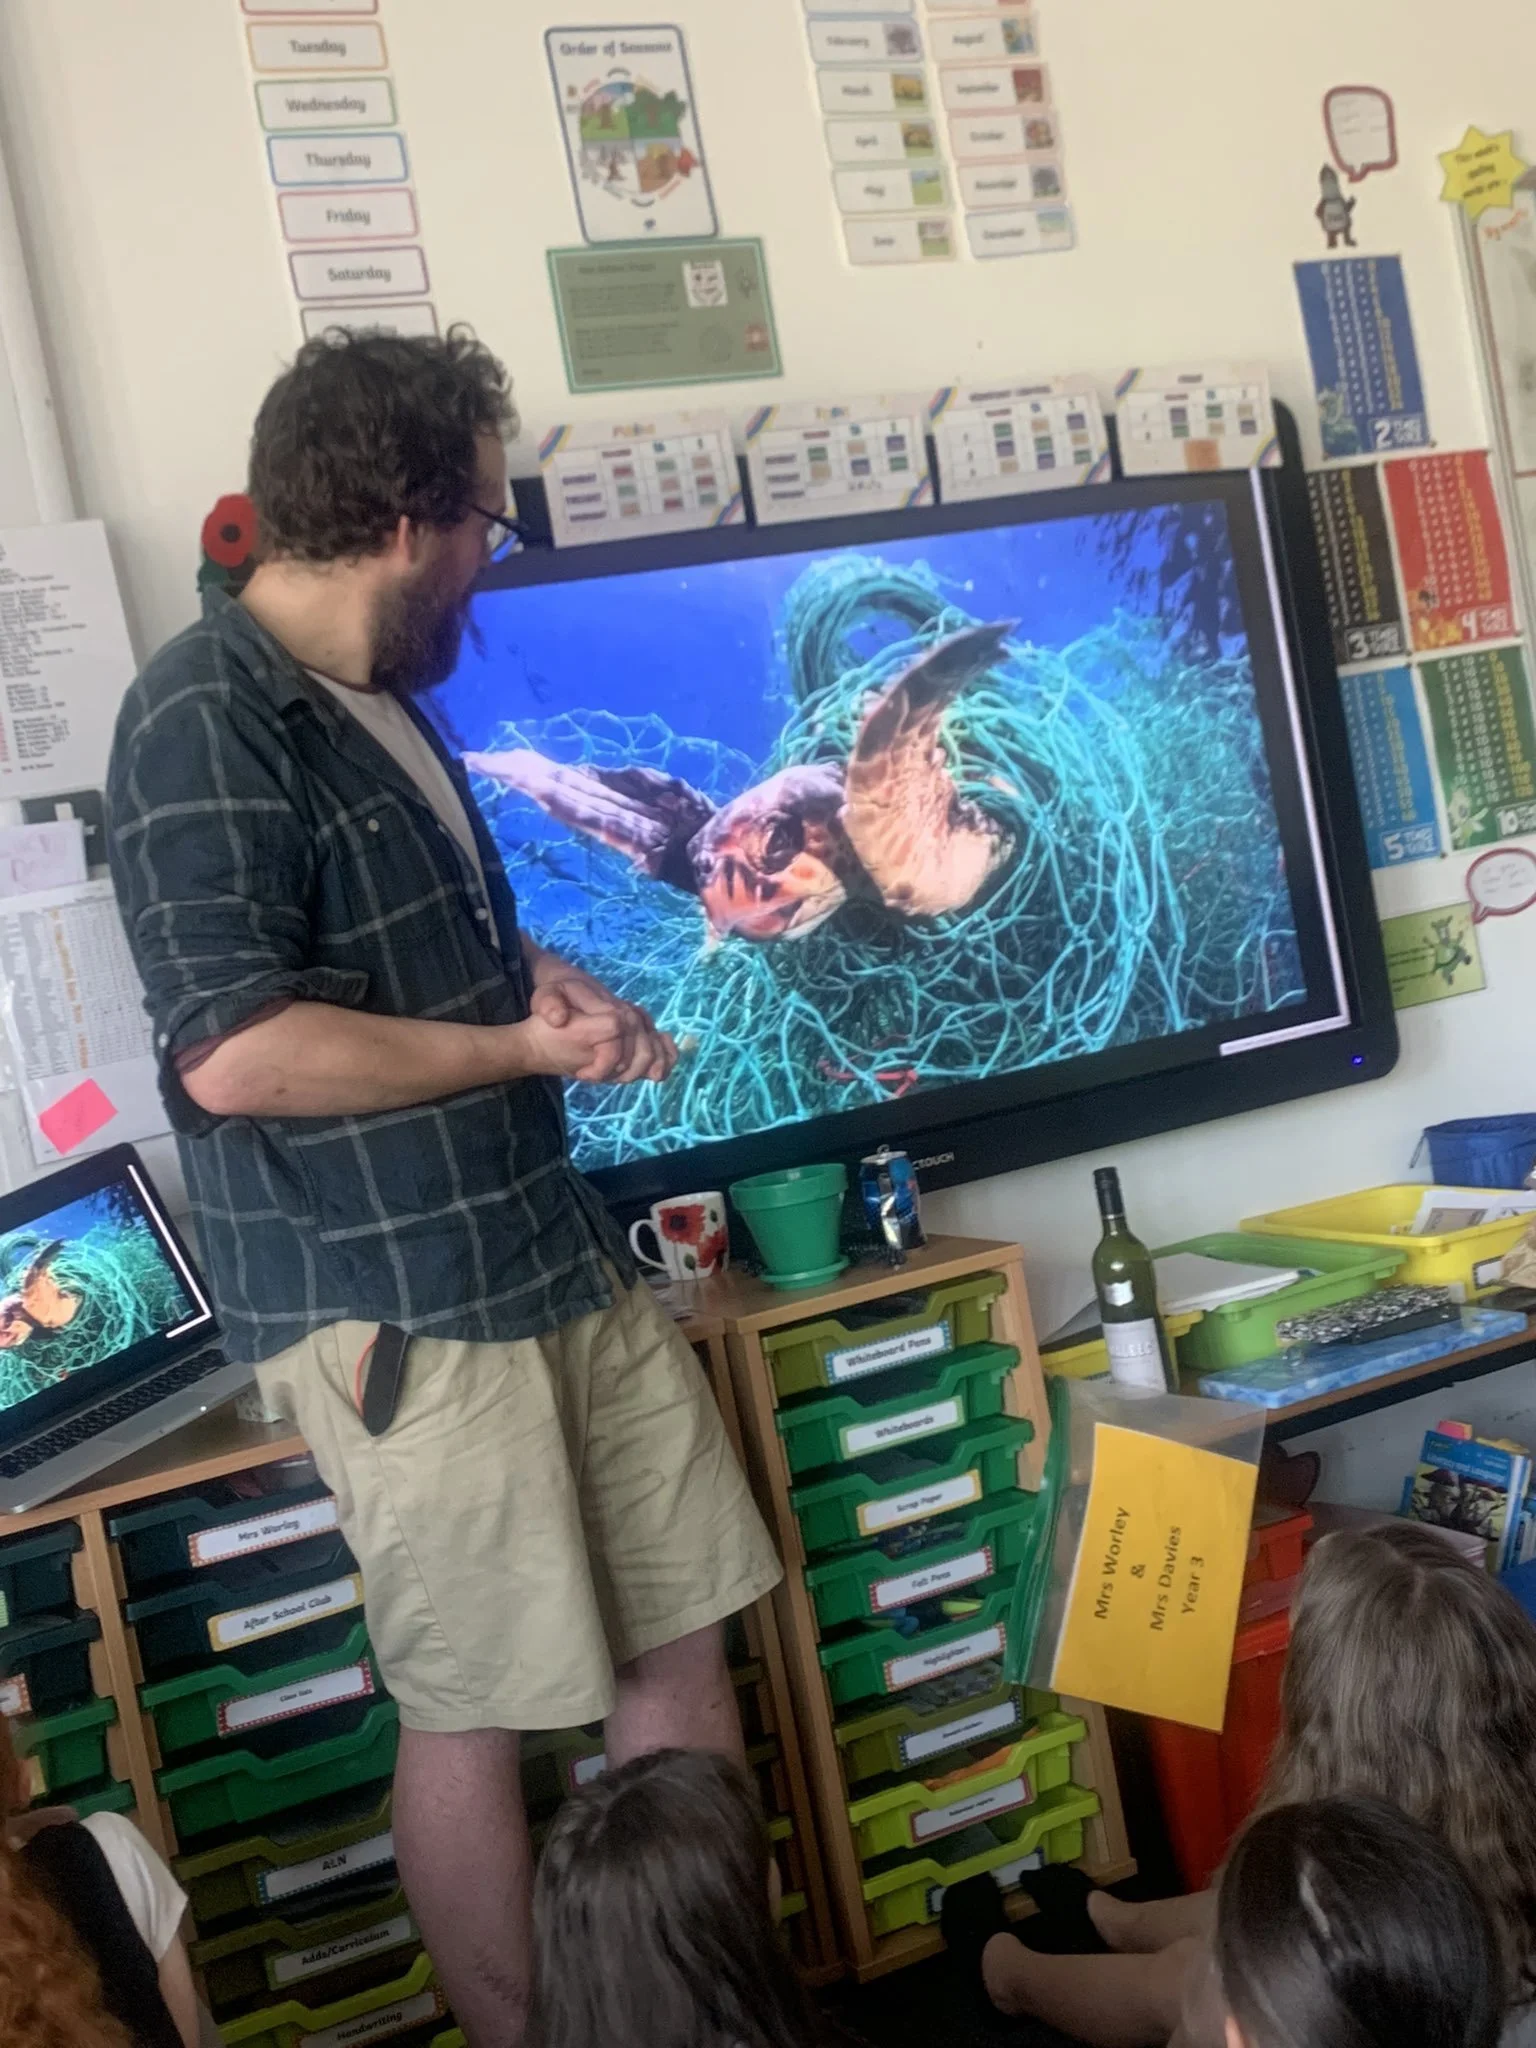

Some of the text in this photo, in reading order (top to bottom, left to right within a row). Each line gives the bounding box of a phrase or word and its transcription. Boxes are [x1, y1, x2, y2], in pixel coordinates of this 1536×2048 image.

[290, 38, 347, 57] Tuesday
[560, 42, 597, 55] Order
[603, 40, 616, 58] of
[285, 96, 367, 114] Wednesday
[305, 151, 371, 169] Thursday
[325, 208, 371, 226] Friday
[327, 264, 392, 283] Saturday
[1374, 418, 1392, 448] 2
[1461, 611, 1477, 639] 4
[1348, 630, 1369, 659] 3
[1384, 831, 1405, 861] 5
[846, 1336, 932, 1368] Whiteboard Pens
[874, 1414, 935, 1438] Whiteboards
[238, 1530, 259, 1541] Mrs
[1094, 1505, 1130, 1620] Mrs Worley
[1130, 1563, 1146, 1580] &
[1150, 1525, 1181, 1632] Mrs Davies
[1181, 1555, 1205, 1615] Year 3
[243, 1594, 333, 1631] After School Club
[321, 1854, 349, 1872] ALN
[336, 2011, 404, 2043] Handwriting
